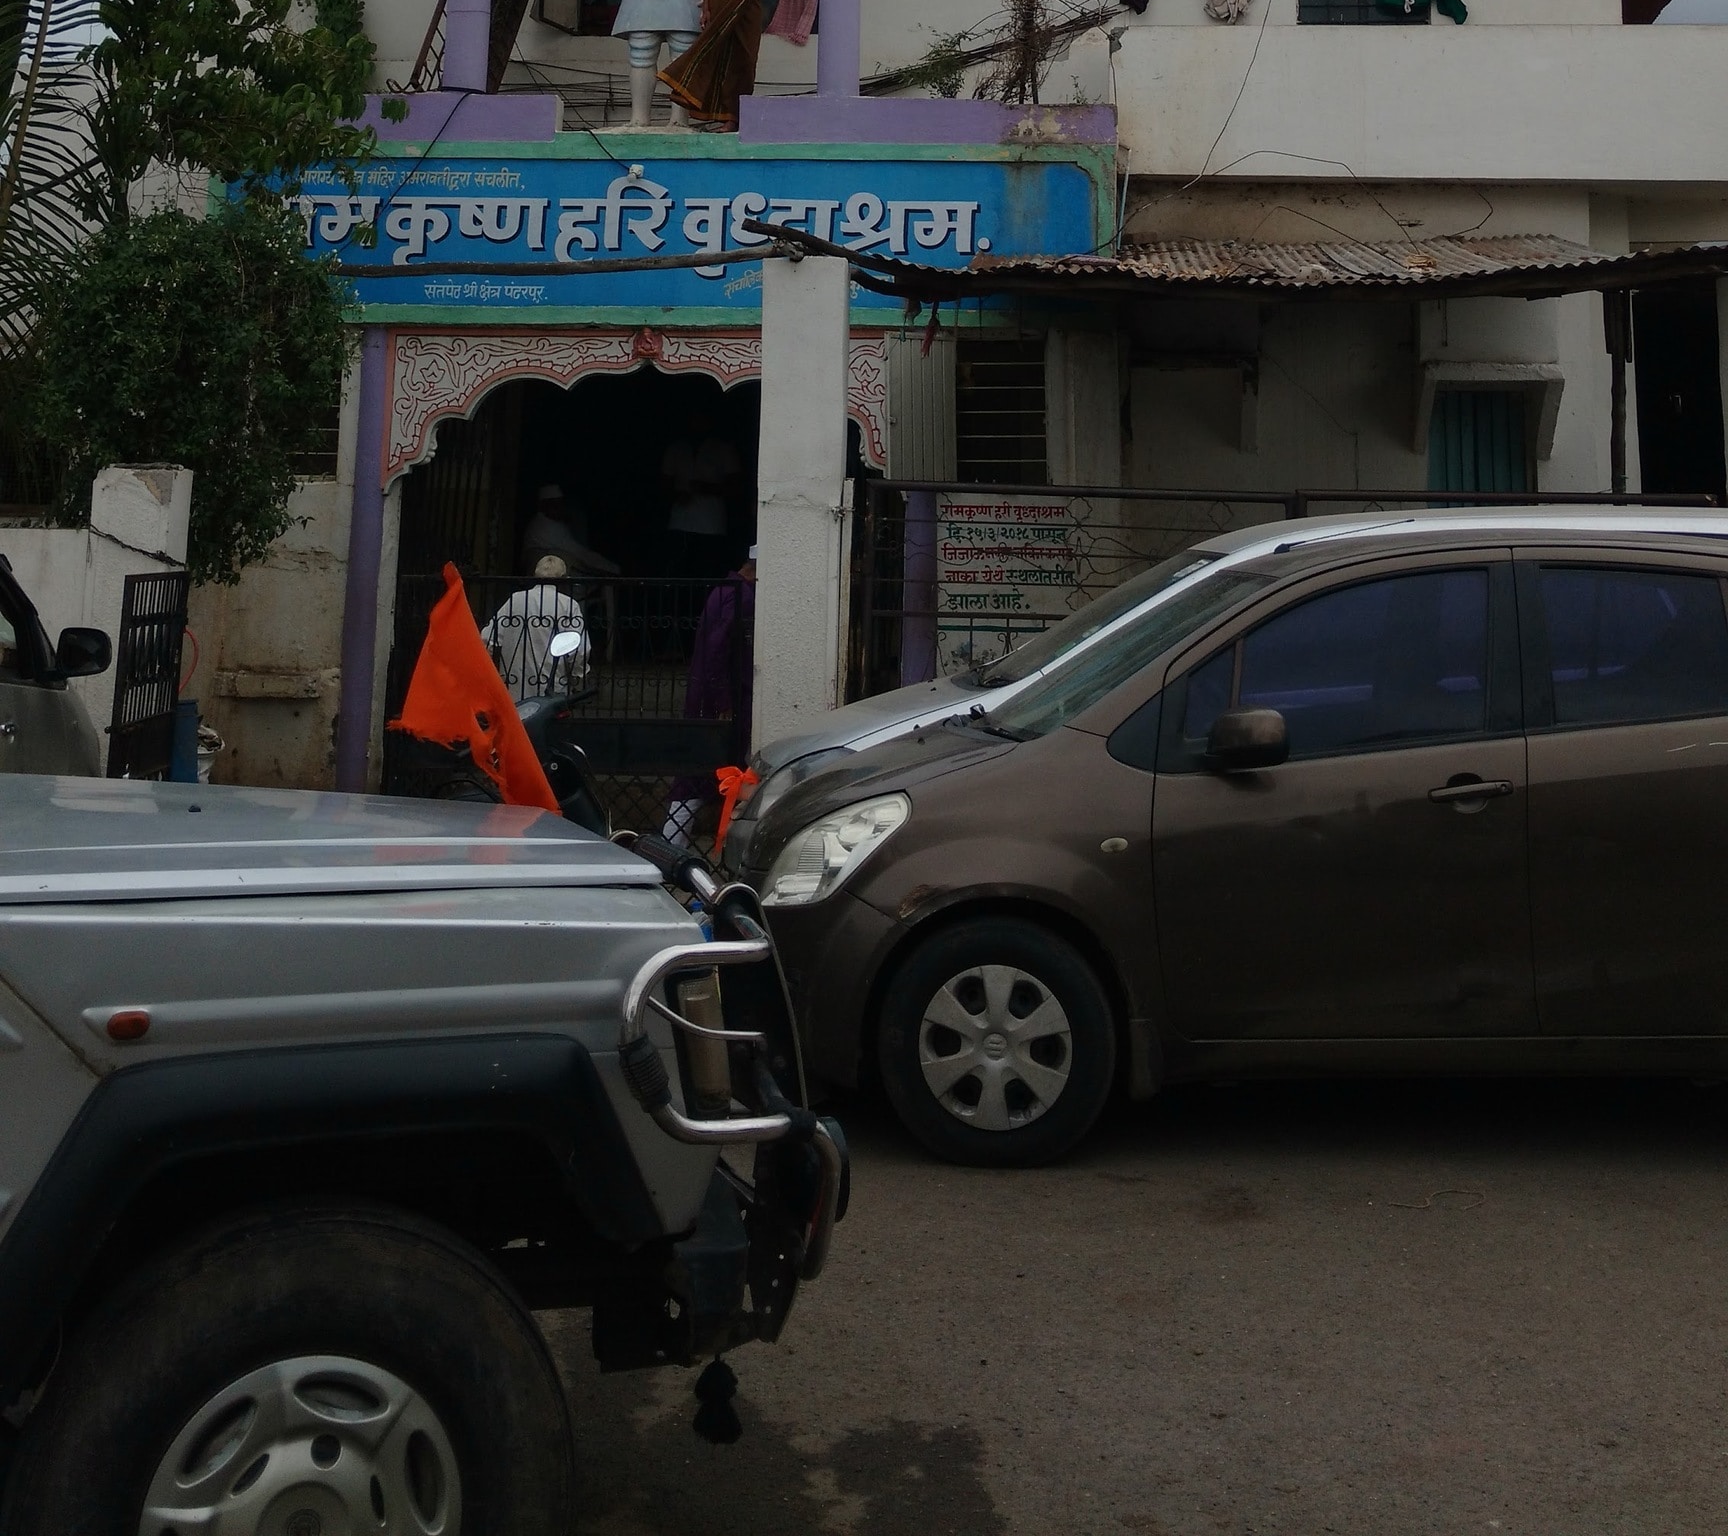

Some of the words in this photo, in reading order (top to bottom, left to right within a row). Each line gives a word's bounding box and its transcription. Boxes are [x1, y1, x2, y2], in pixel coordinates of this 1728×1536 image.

[386, 197, 550, 265] कृष्ण
[555, 177, 673, 262] हरि
[463, 281, 478, 298] श्री
[480, 280, 501, 301] क्षेत्र
[940, 504, 993, 521] रामकृष्ण
[995, 501, 1012, 521] हरी
[1030, 528, 1068, 544] पासून
[945, 570, 979, 582] नाका
[981, 565, 1005, 583] येथे
[948, 593, 989, 610] झाला
